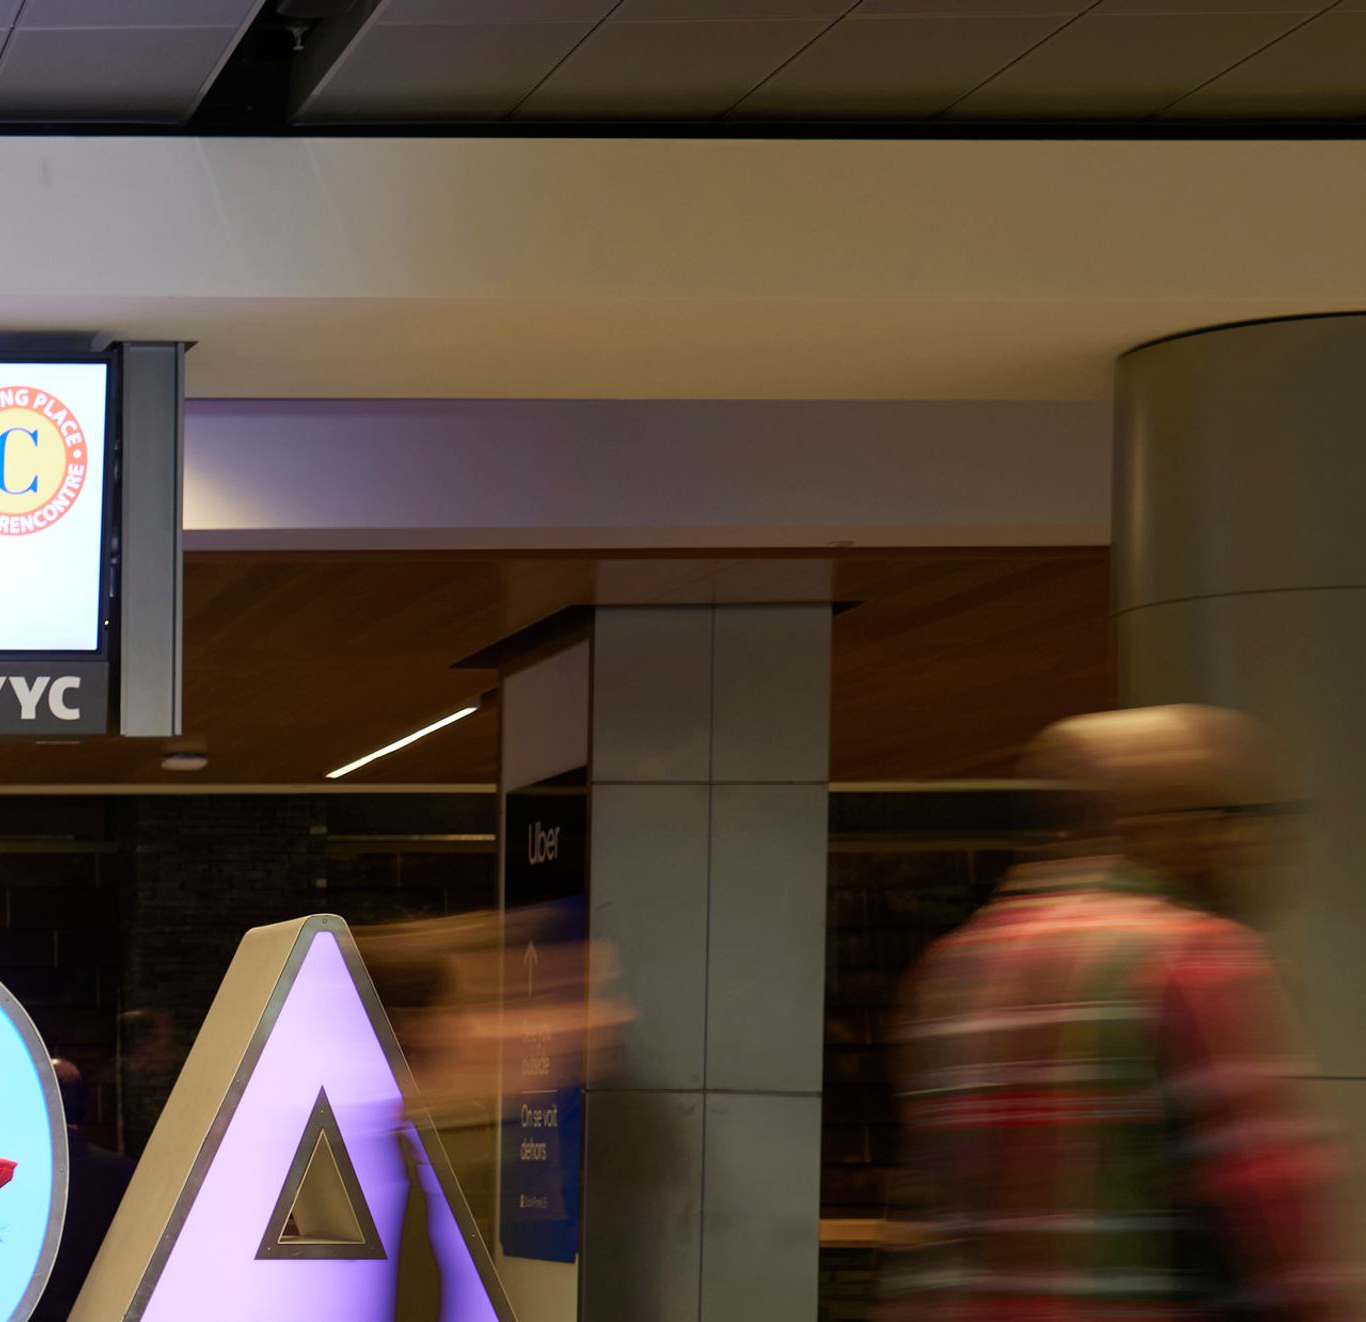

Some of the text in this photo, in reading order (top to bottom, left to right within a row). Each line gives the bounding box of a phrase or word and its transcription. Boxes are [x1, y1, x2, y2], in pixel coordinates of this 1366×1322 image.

[33, 392, 83, 447] PLACE
[528, 820, 560, 865] Uber
[521, 1104, 533, 1128] On
[533, 1109, 542, 1128] se
[520, 1137, 547, 1161] dehors
